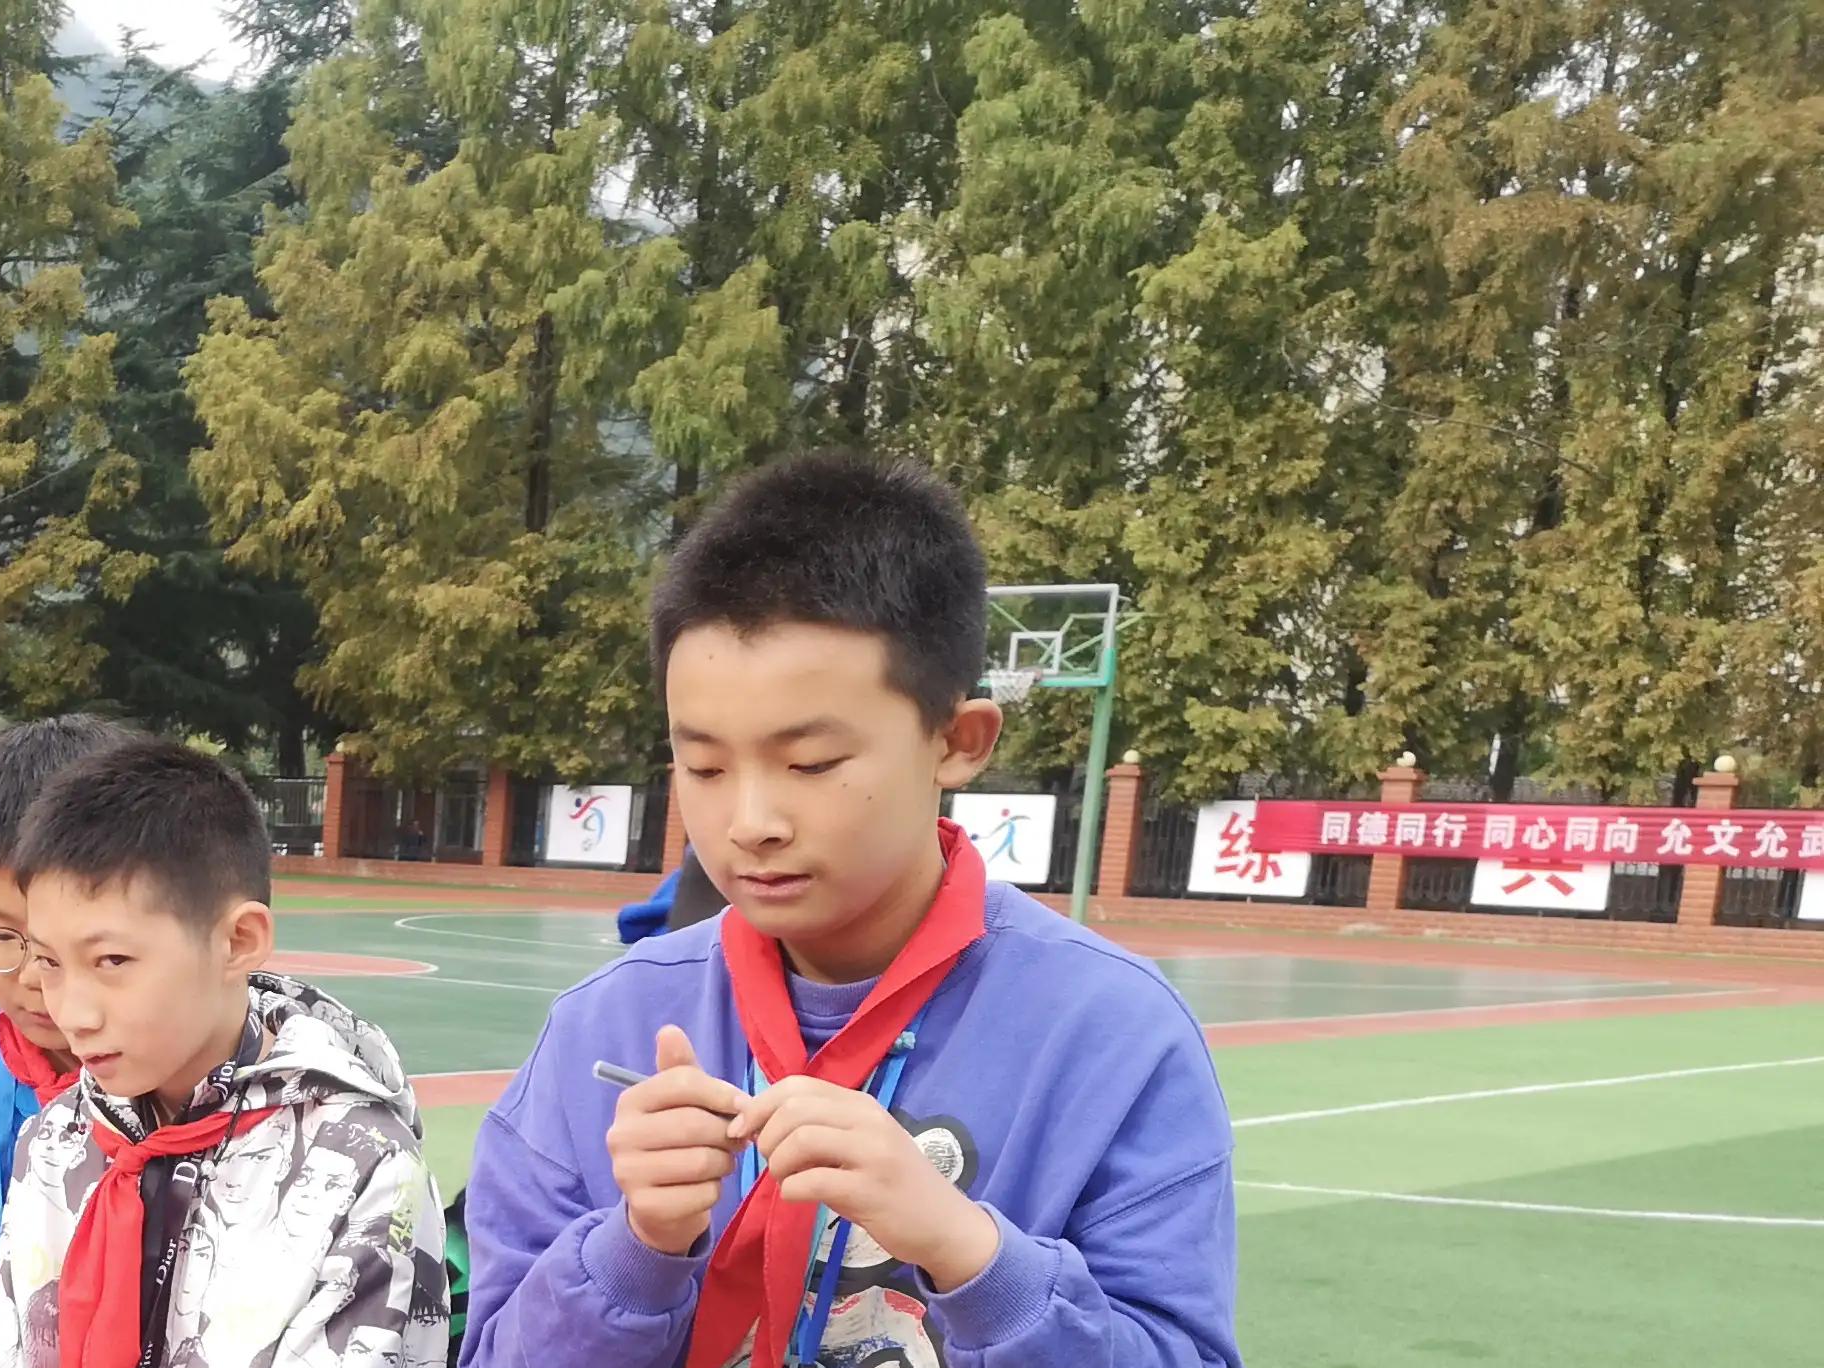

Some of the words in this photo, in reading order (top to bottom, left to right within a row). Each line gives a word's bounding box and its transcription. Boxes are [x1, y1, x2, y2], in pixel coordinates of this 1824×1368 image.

[1320, 811, 1467, 848] 同德同行
[1482, 814, 1639, 854] 同心同向
